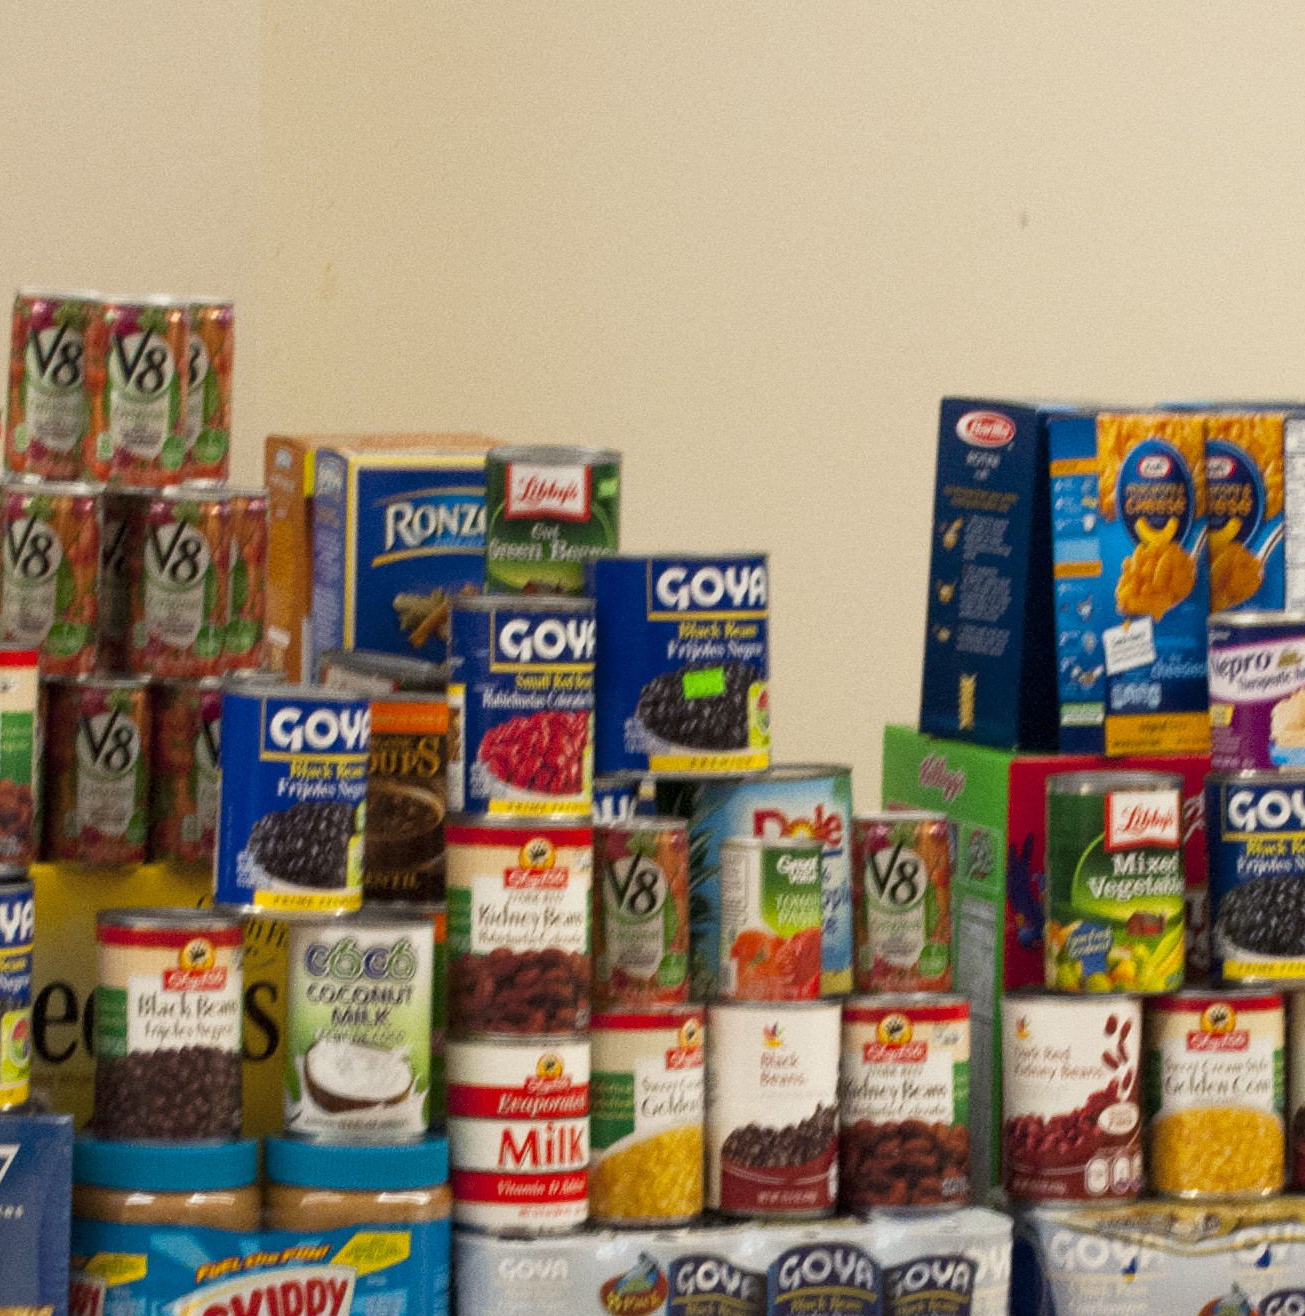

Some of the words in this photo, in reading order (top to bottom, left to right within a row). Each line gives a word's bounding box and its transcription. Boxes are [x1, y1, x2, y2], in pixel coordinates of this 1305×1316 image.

[29, 322, 85, 389] V8
[111, 324, 168, 394] V8
[6, 513, 53, 580] V8
[385, 500, 486, 553] RONZ
[489, 536, 543, 561] Green
[150, 517, 202, 584] V8
[656, 563, 769, 610] GOYA
[81, 705, 135, 774] V8
[1121, 803, 1175, 836] Libby's
[603, 850, 660, 915] V8
[869, 838, 920, 906] V8
[1111, 850, 1182, 876] Mixed
[306, 983, 414, 1005] COCONUT
[331, 1005, 391, 1028] MILK
[760, 1051, 800, 1071] Black
[760, 1070, 807, 1087] Beans
[497, 1122, 585, 1168] Milk
[778, 1245, 877, 1292] GOYA
